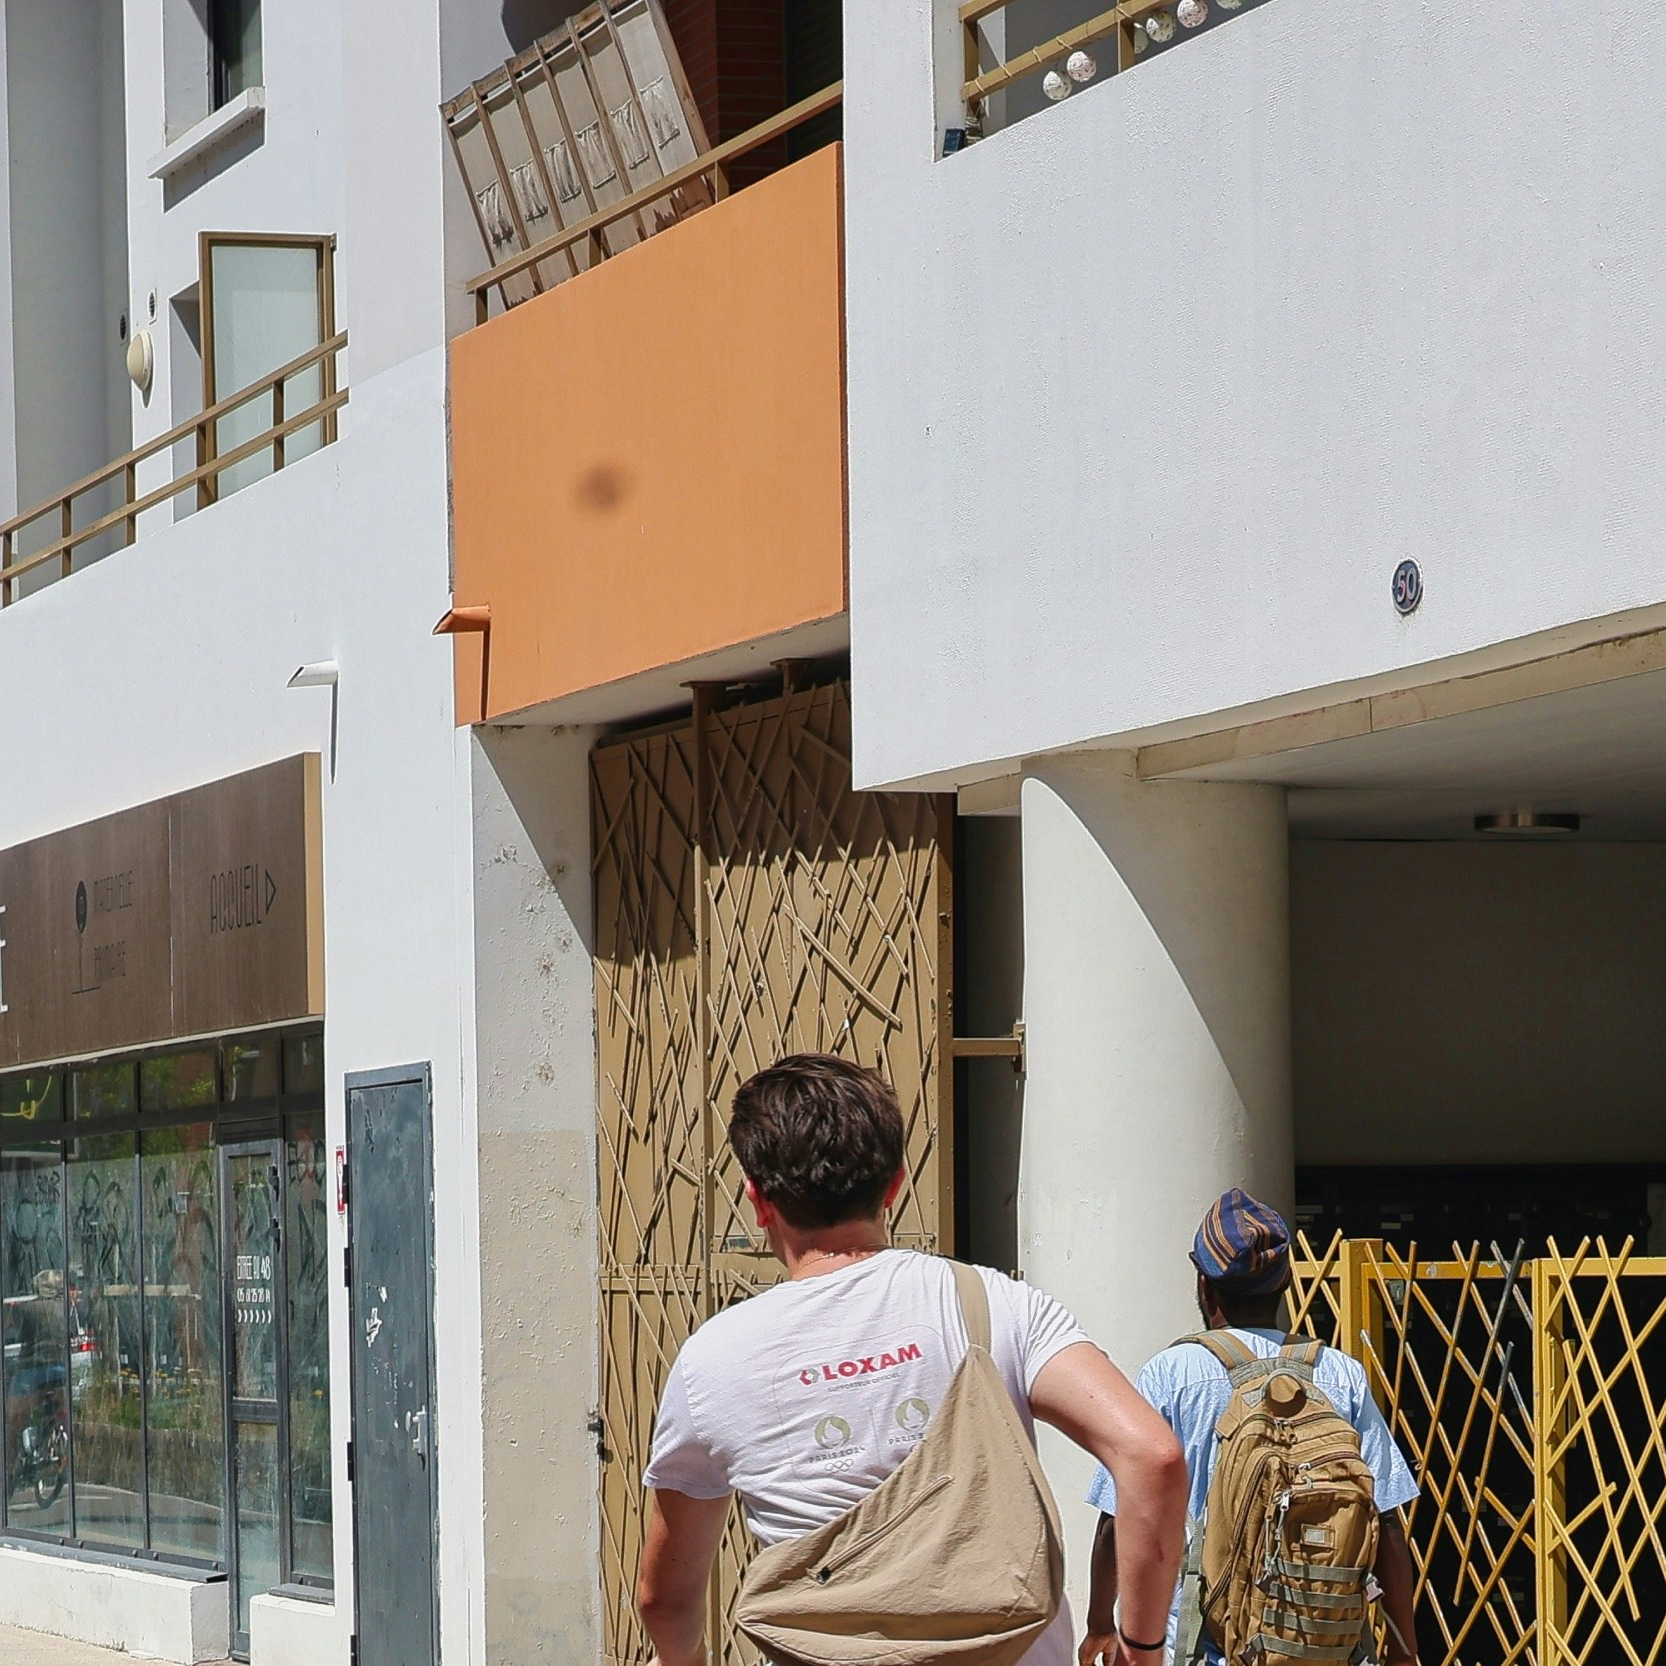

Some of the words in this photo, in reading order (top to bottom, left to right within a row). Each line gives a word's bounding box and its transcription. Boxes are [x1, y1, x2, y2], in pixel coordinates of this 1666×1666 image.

[1396, 567, 1417, 603] 50
[210, 863, 263, 936] ACCUEIL
[823, 1343, 923, 1381] LOXAM
